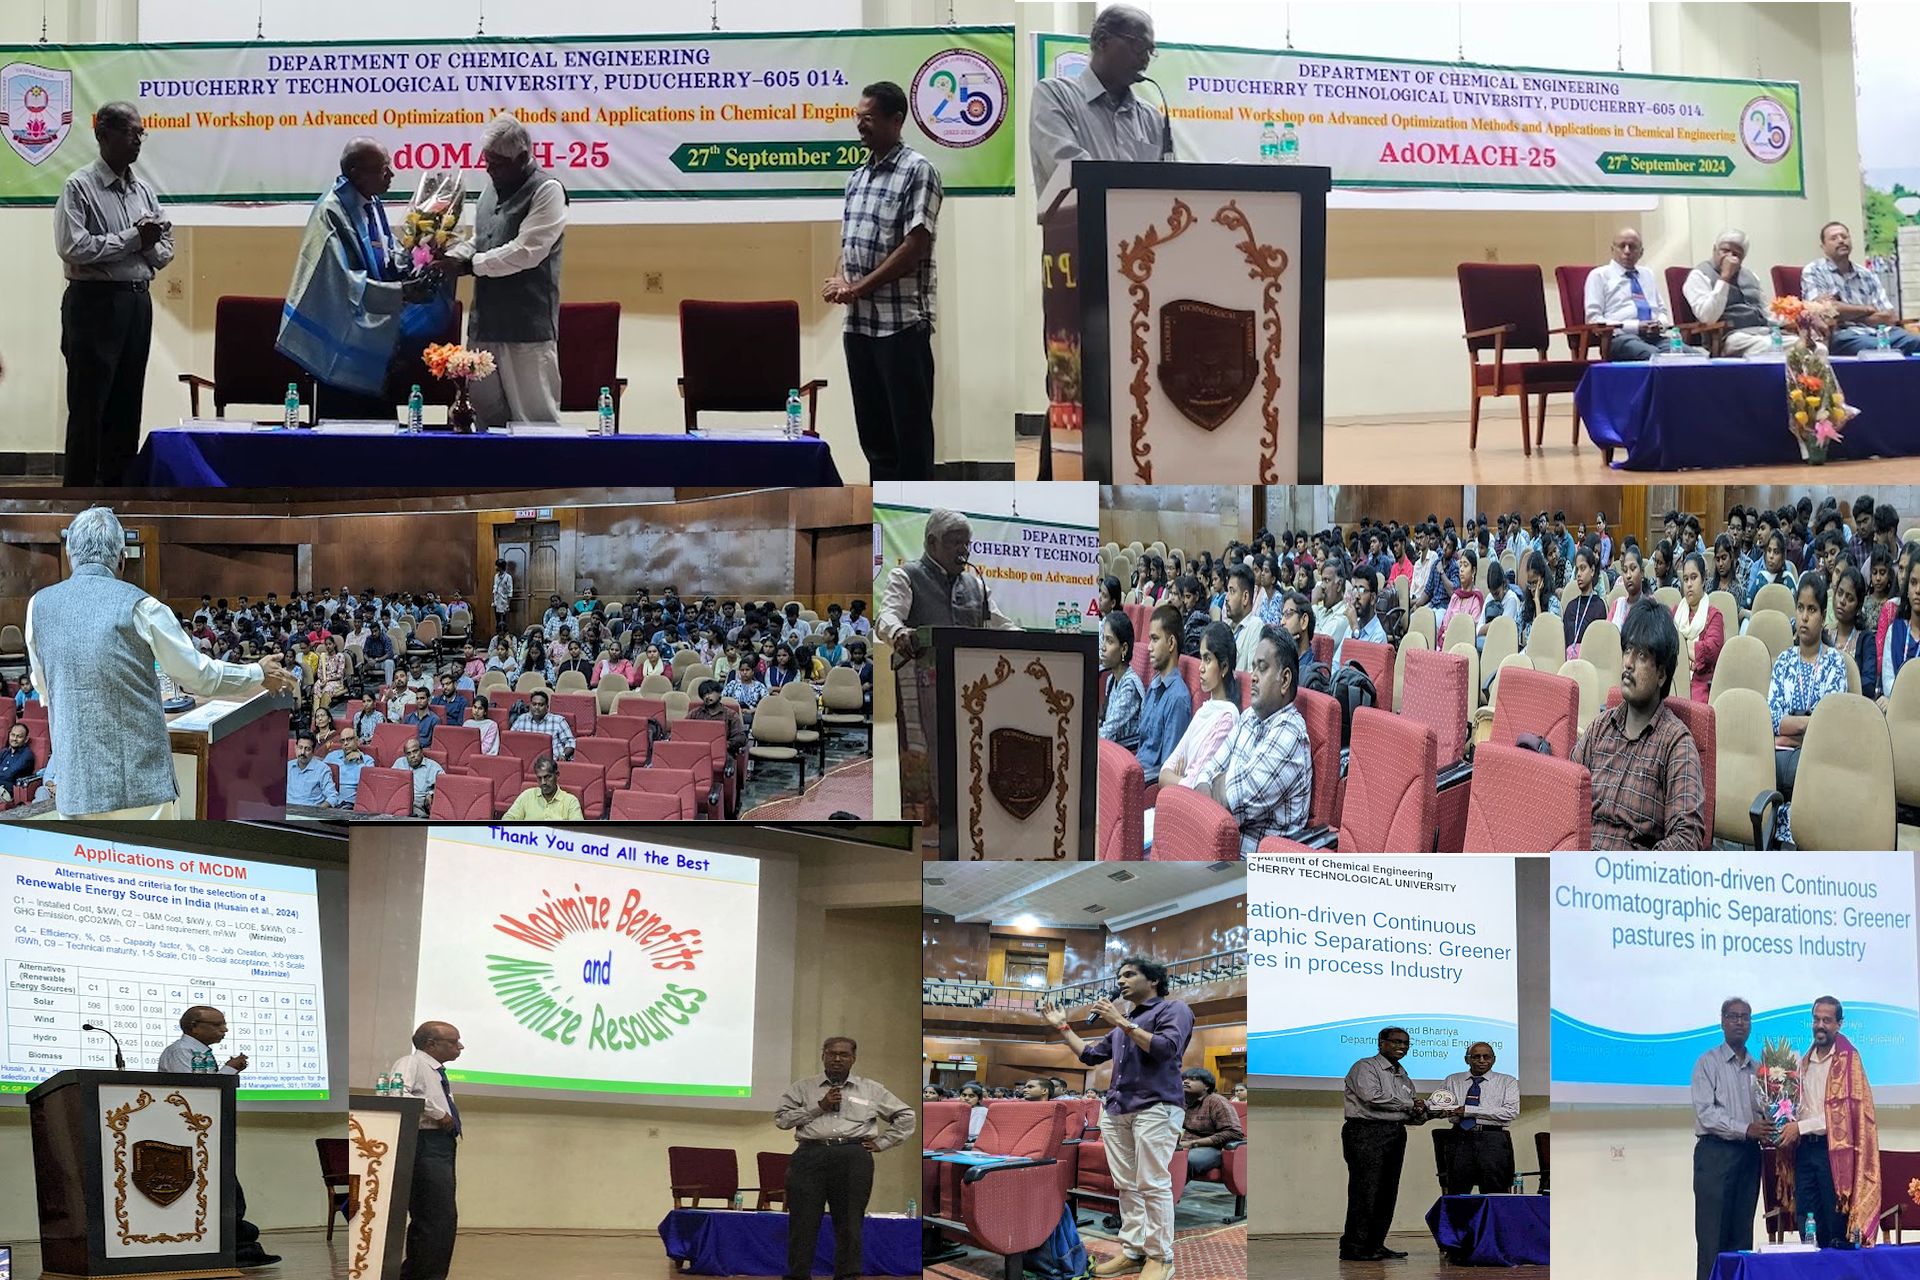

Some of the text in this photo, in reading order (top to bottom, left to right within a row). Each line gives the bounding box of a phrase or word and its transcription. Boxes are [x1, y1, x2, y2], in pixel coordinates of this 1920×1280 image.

[268, 48, 710, 72] DEPARTMENT OF CHEMICAL ENGINEERING
[139, 78, 279, 97] PUDUCHERRY
[285, 75, 459, 95] TECHNOLOGICAL
[466, 73, 598, 93] UNIVERSITY,
[807, 69, 849, 87] 014.
[1299, 63, 1619, 96] DEPARTMENT OF CHEMICAL ENGINEERING
[1188, 77, 1307, 96] PUDUCHERRY
[1314, 84, 1448, 104] TECHNOLOGICAL
[1453, 92, 1547, 110] UNIVERSITY,
[1679, 103, 1704, 117] 014.
[196, 110, 275, 130] Workshop
[279, 114, 297, 127] on
[302, 109, 378, 127] Advanced
[383, 107, 484, 128] Optimization
[561, 106, 590, 123] and
[595, 104, 695, 128] Applications
[700, 104, 715, 121] in
[720, 102, 797, 120] Chemical
[1238, 107, 1305, 125] Workshop
[1309, 113, 1323, 124] on
[1328, 111, 1387, 126] Advanced
[1391, 113, 1467, 130] Optimization
[1471, 118, 1518, 132] Methods
[1522, 121, 1541, 133] and
[1546, 123, 1611, 138] Applications
[1614, 126, 1624, 137] in
[1627, 126, 1674, 139] Chemical
[1677, 128, 1736, 144] Engineering
[687, 144, 871, 170] 27th September 202
[1379, 142, 1556, 168] AdOMACH-25
[1606, 154, 1726, 174] 27th September 2024
[1030, 571, 1042, 581] on
[1045, 571, 1093, 585] Advanced
[488, 825, 710, 872] Thank You and All the Best
[74, 844, 247, 880] Applications of MCDM
[1308, 857, 1319, 867] of
[1322, 859, 1369, 872] Chemical
[1373, 864, 1433, 880] Engineering
[55, 867, 115, 884] Alternatives
[118, 876, 136, 886] and
[138, 879, 171, 891] criteria
[174, 883, 187, 893] for
[189, 885, 204, 895] the
[206, 887, 247, 900] selection
[249, 893, 258, 901] of
[1248, 862, 1456, 893] CHERRY TECHNOLOGICAL UNIVERSITY
[1595, 856, 1878, 899] Optimization-driven Continuous
[13, 895, 133, 917] C1 Installed Cost, C2
[16, 875, 82, 893] Renewable
[85, 884, 126, 900] Energy
[129, 890, 168, 904] Source
[172, 895, 182, 905] in
[185, 897, 211, 909] India
[214, 901, 248, 913] (Husain
[250, 905, 259, 914] et
[276, 908, 299, 919] 2024)
[1555, 885, 1911, 929] Chromatographic Separations: Greener
[13, 906, 35, 917] GHG
[1373, 911, 1476, 936] Continuous
[14, 925, 27, 934] C4
[493, 882, 704, 971] Maximize Benefits
[66, 941, 105, 953] Technical
[1314, 930, 1433, 956] Separations:
[1439, 940, 1512, 961] Greener
[1612, 925, 1867, 962] pastures in process Industry
[18, 962, 66, 973] Alternatives
[19, 972, 66, 983] (Renewable
[250, 967, 290, 979] (Maximize)
[583, 950, 612, 985] and
[1284, 952, 1301, 970] in
[1308, 958, 1384, 976] process
[1391, 960, 1463, 984] Industry
[10, 981, 76, 995] Energy Sources)
[119, 986, 130, 994] C2
[171, 990, 181, 998] C4
[190, 978, 216, 987] Criteria
[33, 996, 54, 1006] Solar
[485, 954, 708, 1051] Minimize Resources
[34, 1014, 55, 1023] Wind
[33, 1032, 57, 1042] Hydro
[1409, 1038, 1450, 1048] Chemical
[1422, 1026, 1459, 1038] Bhartiya
[28, 1051, 63, 1060] Biomass
[1412, 1049, 1449, 1059] Bombay
